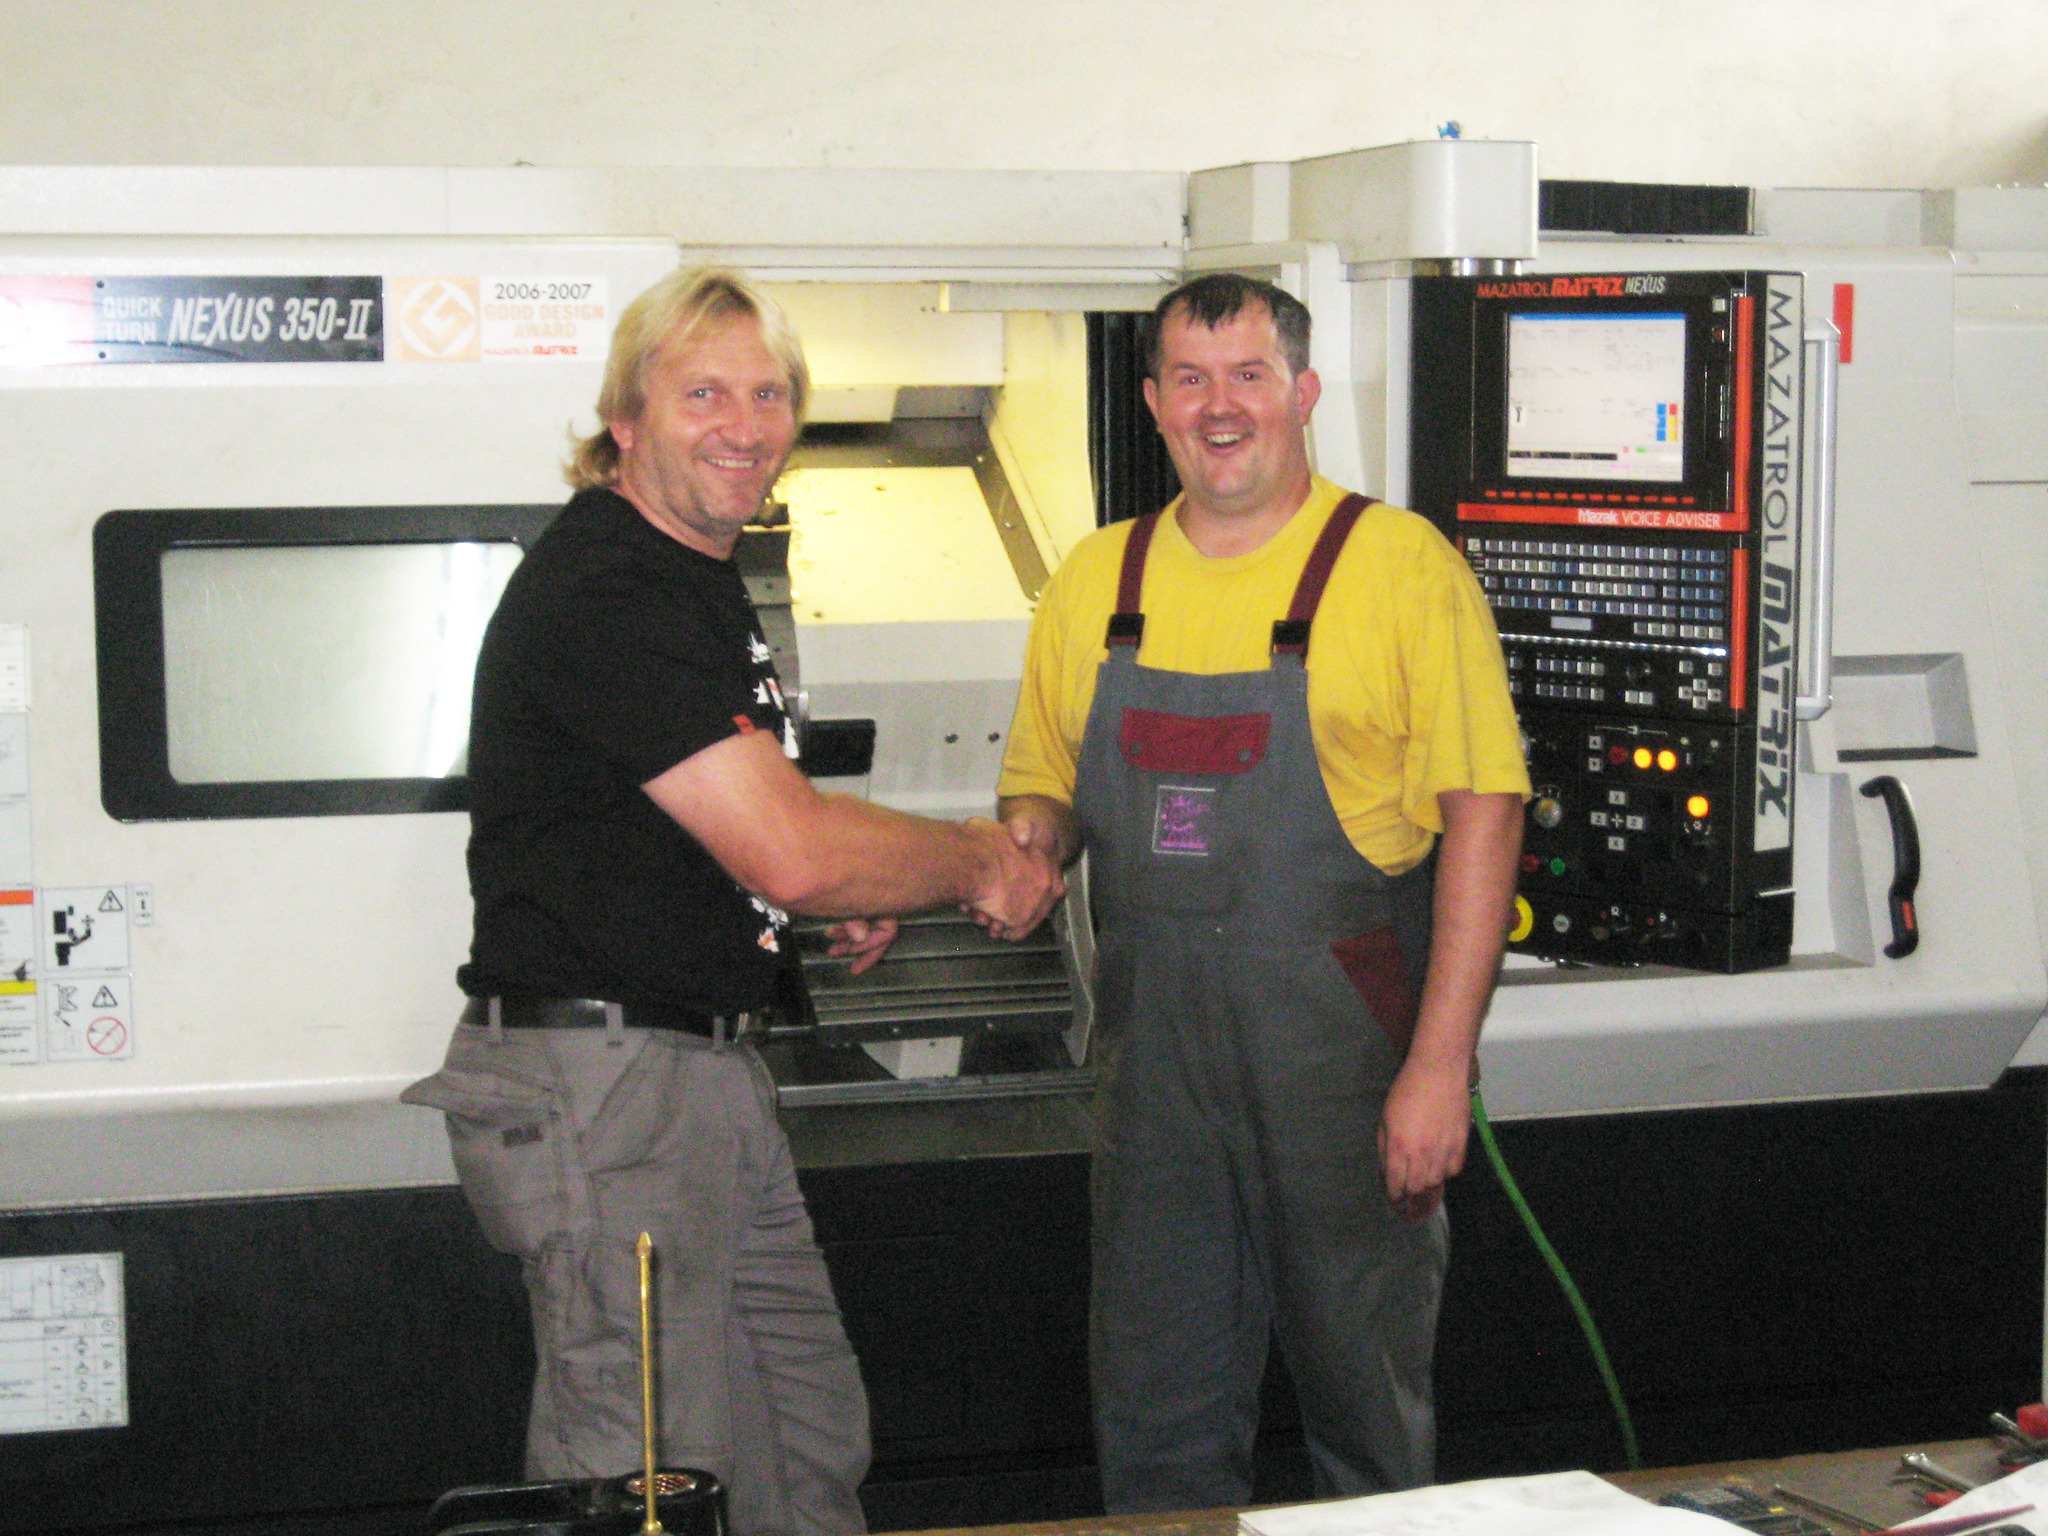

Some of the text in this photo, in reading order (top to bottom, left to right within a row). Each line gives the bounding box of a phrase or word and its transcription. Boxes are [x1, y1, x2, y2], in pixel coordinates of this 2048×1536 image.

[495, 283, 592, 300] 2006-2007
[1476, 282, 1550, 298] MAZATROL
[1625, 274, 1666, 295] NEXUS
[102, 296, 162, 318] QUICK
[484, 304, 605, 320] GOOD DESIGN
[168, 292, 374, 346] NEXUS 350-II
[104, 320, 157, 343] TURN
[514, 322, 577, 339] AWARD
[1764, 289, 1794, 553] MAZATROL
[1578, 509, 1721, 529] Mazak VOICE ADVISER
